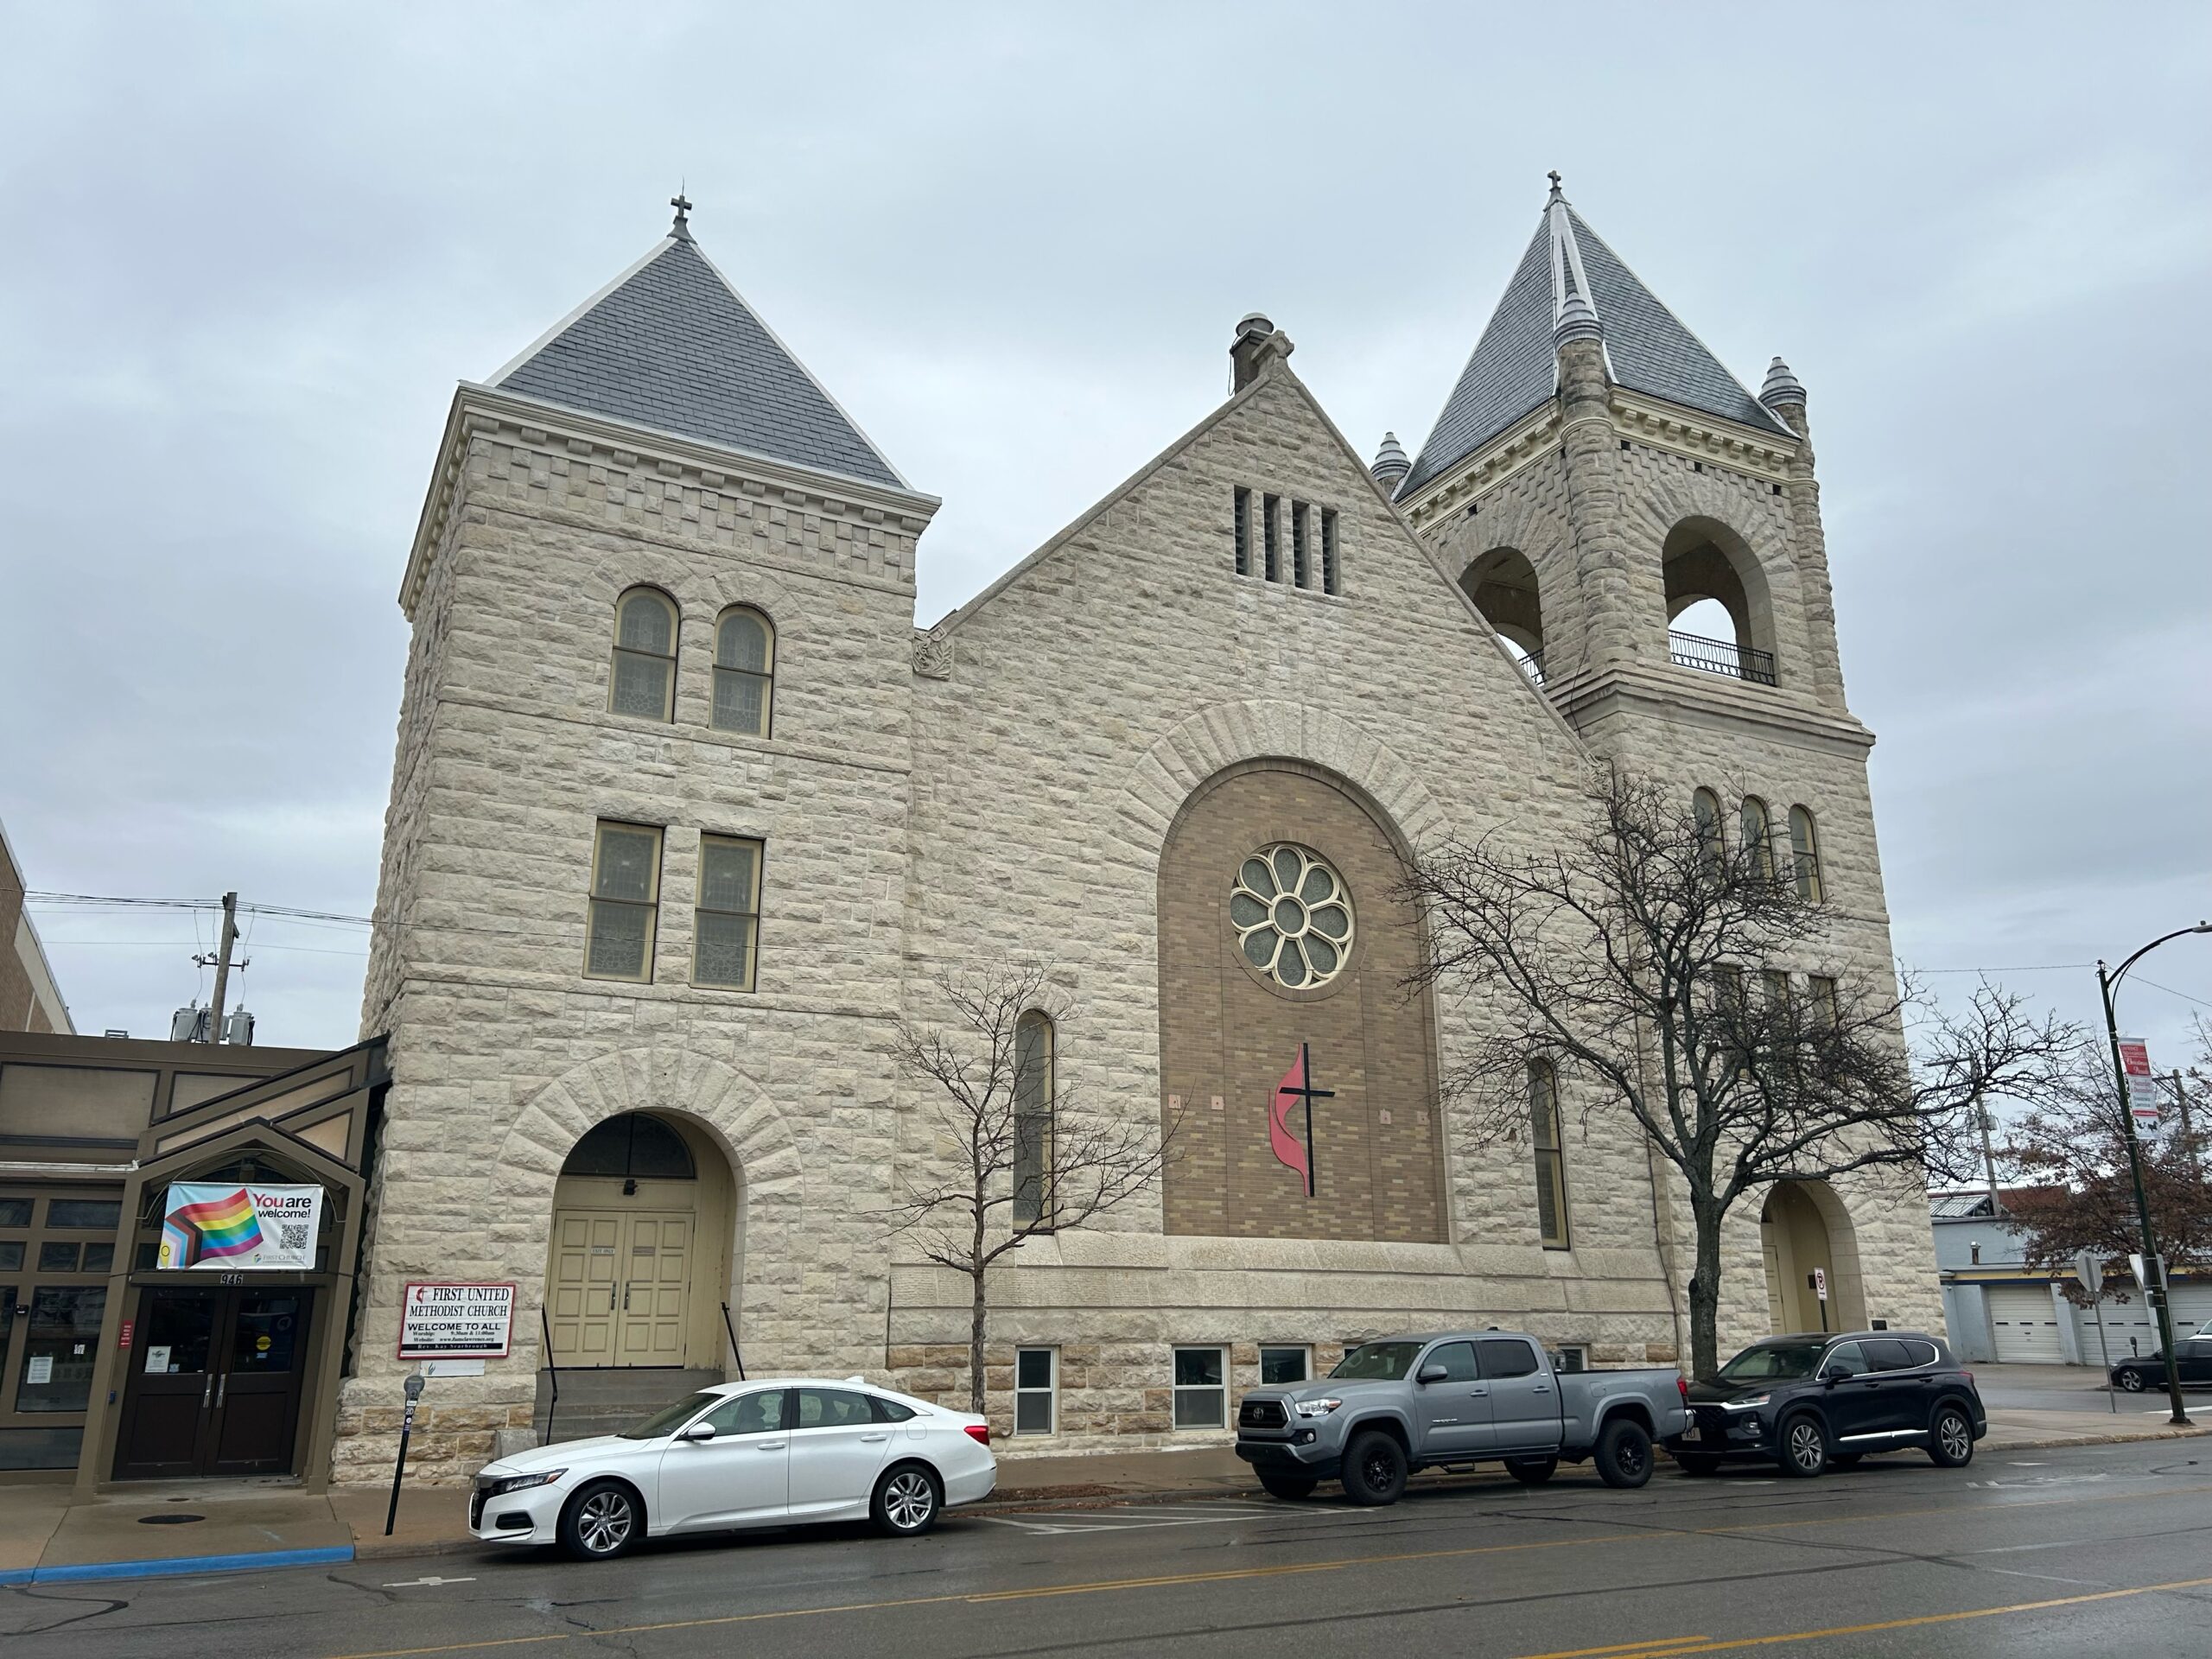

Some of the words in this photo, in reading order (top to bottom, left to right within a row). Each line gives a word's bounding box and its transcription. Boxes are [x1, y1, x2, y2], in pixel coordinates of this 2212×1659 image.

[253, 1193, 284, 1208] You
[285, 1197, 312, 1208] are
[258, 1209, 311, 1218] welcome!
[221, 1274, 242, 1285] 946
[432, 1288, 464, 1300] FIRST
[467, 1288, 509, 1300] UNITED
[410, 1306, 465, 1316] METHODIST
[467, 1306, 507, 1316] CHURCH
